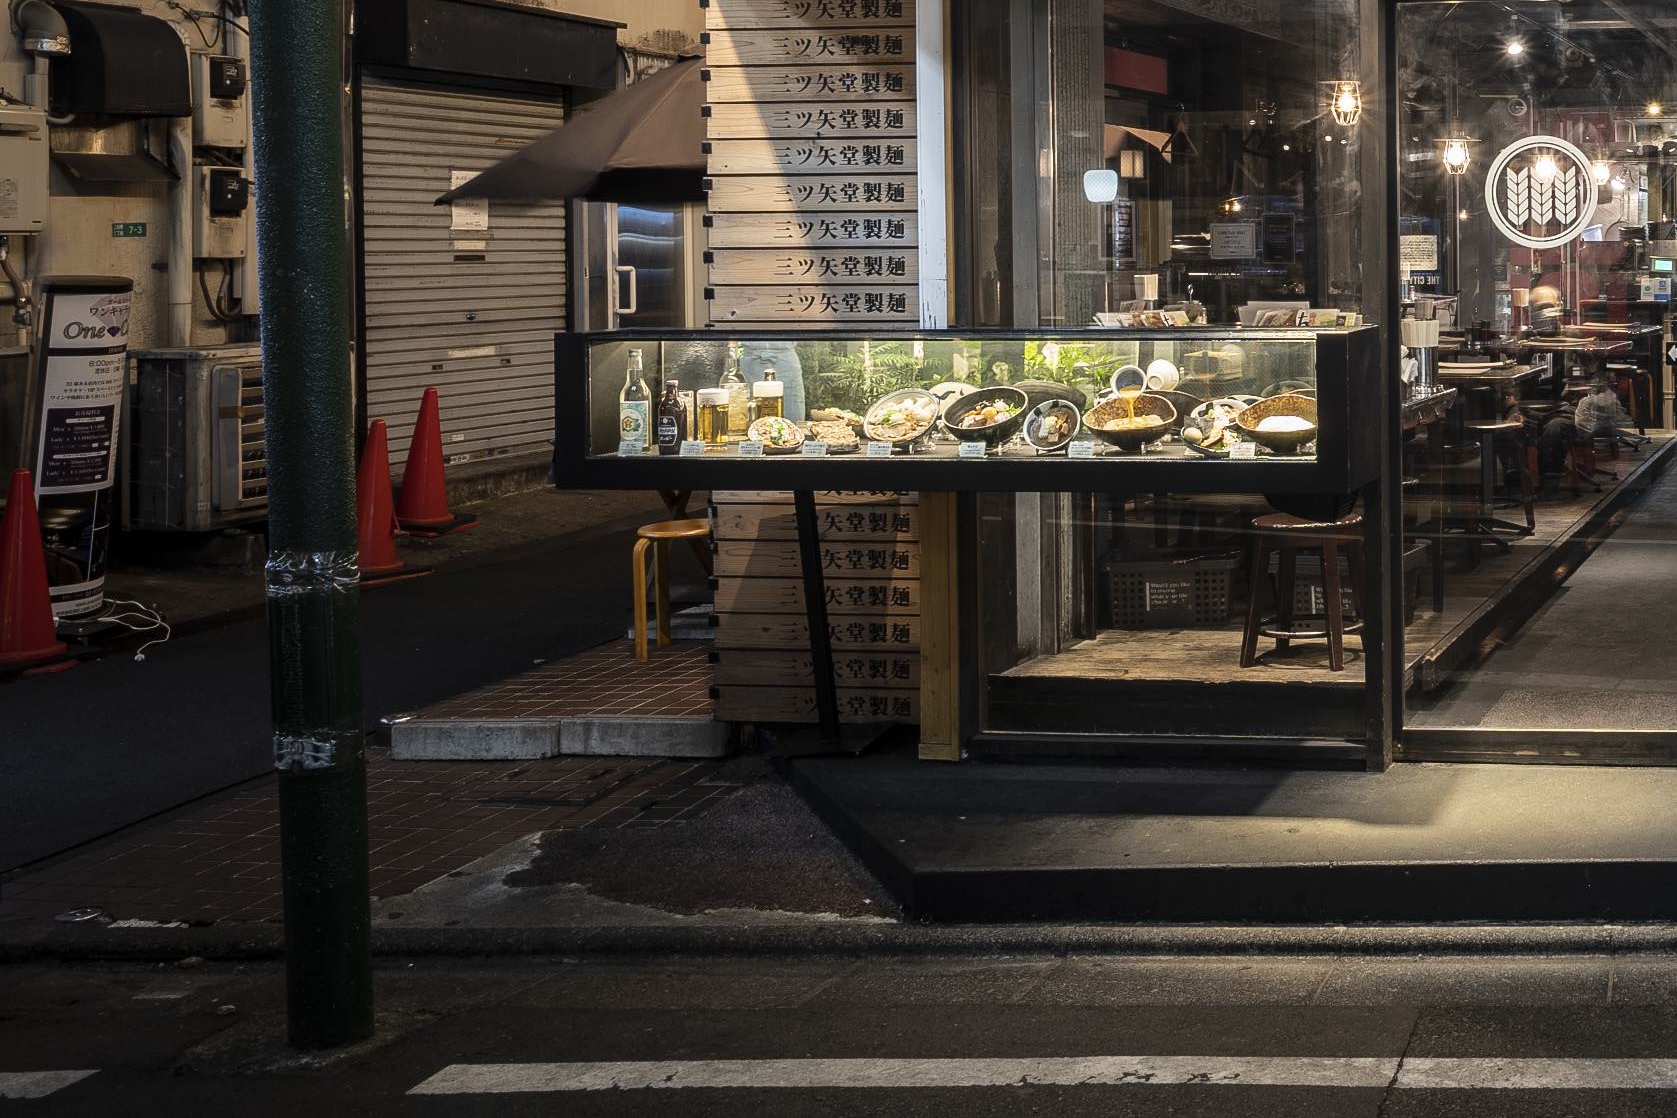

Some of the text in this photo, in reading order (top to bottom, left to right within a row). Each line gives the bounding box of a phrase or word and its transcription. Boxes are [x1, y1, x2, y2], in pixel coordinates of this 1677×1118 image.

[771, 35, 903, 56] 三ツ矢堂製麺
[771, 71, 904, 93] 三ツ矢堂製麺
[772, 108, 904, 130] 三ツ矢堂製麺
[772, 145, 905, 167] 三ツ矢堂製麺
[773, 182, 905, 203] 三ツ矢堂製麺
[128, 225, 143, 235] 7-3
[773, 219, 905, 240] 三ツ矢堂製麺
[774, 256, 906, 277] 三ツ矢堂製麺
[774, 293, 906, 314] 三ツ矢堂製麺
[63, 321, 107, 340] One
[779, 512, 910, 533] 三矢堂製麺
[779, 549, 910, 570] 三矢堂製麺
[779, 586, 910, 606] 三矢堂製麺
[779, 623, 910, 643] 三矢堂製麺
